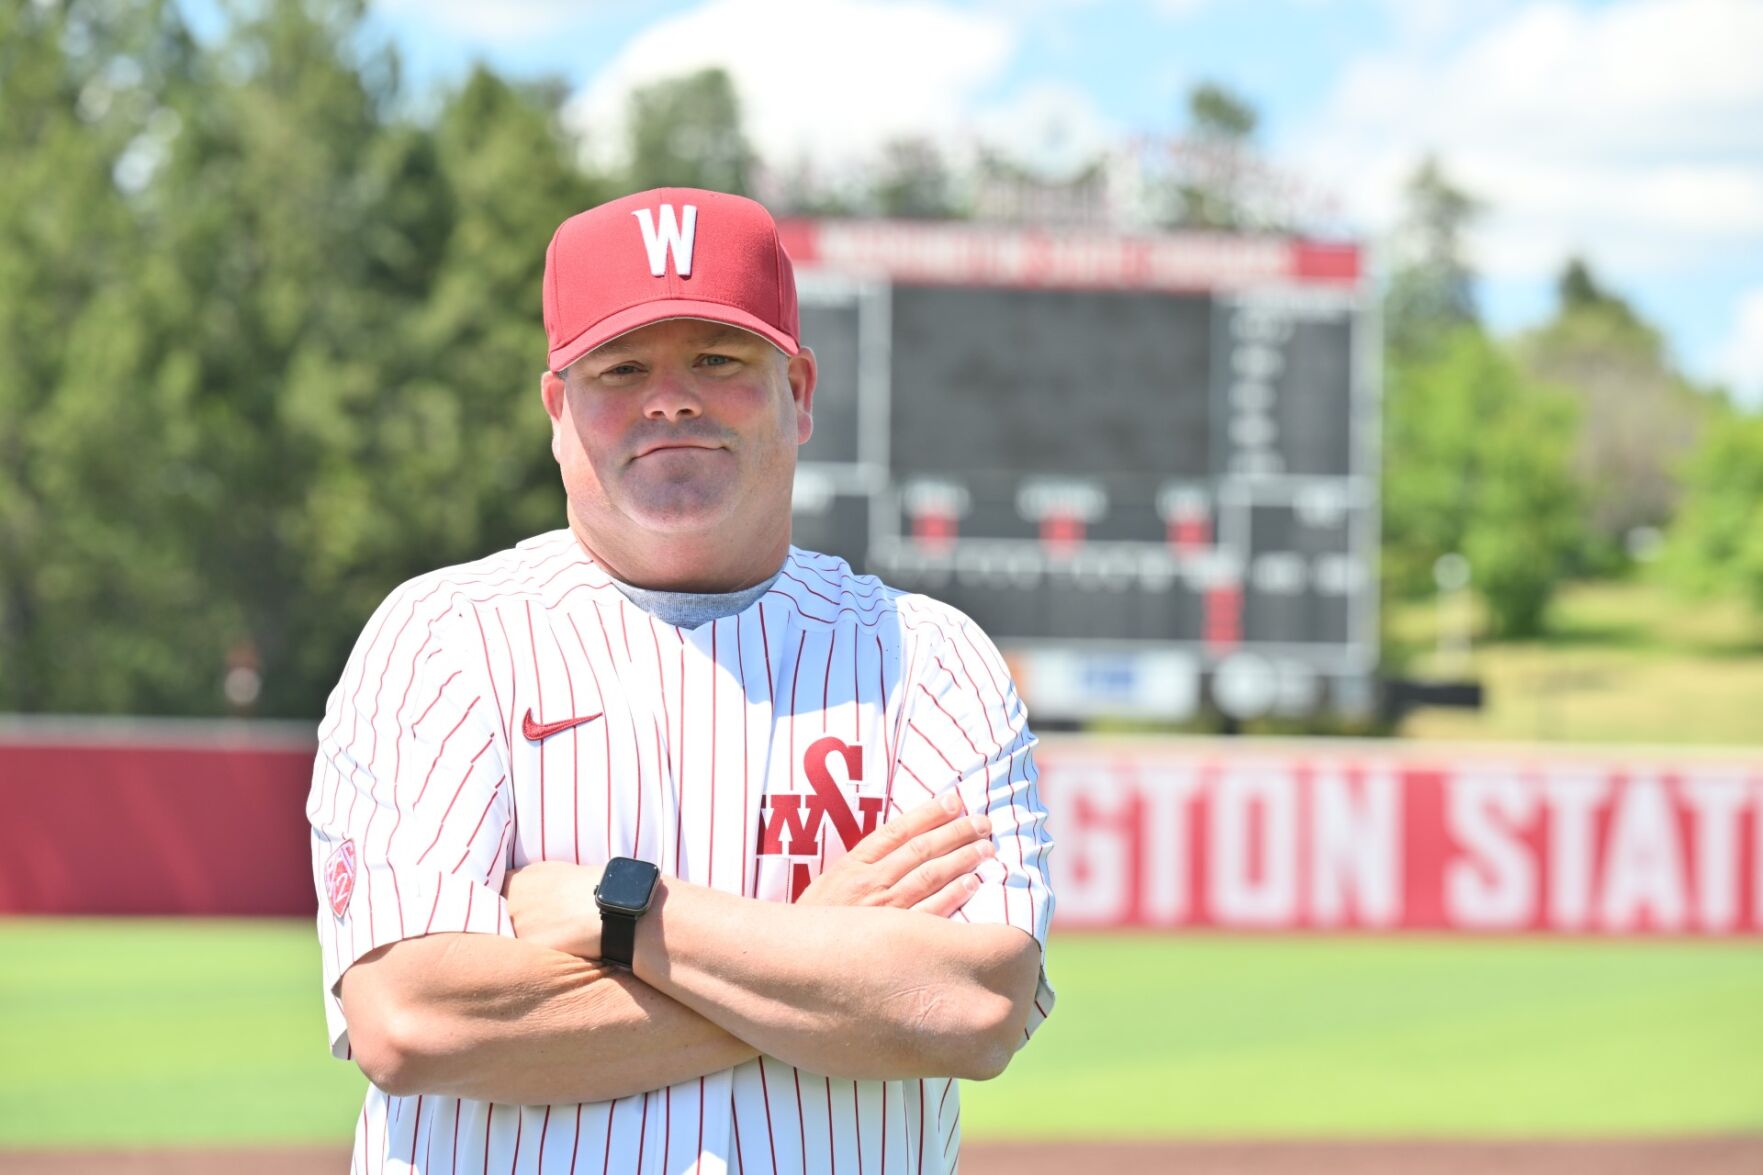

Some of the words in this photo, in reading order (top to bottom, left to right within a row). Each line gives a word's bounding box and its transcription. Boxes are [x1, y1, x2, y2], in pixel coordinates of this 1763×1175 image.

[631, 203, 697, 277] W
[1046, 766, 1399, 927] GTON
[1444, 769, 1763, 932] STAT
